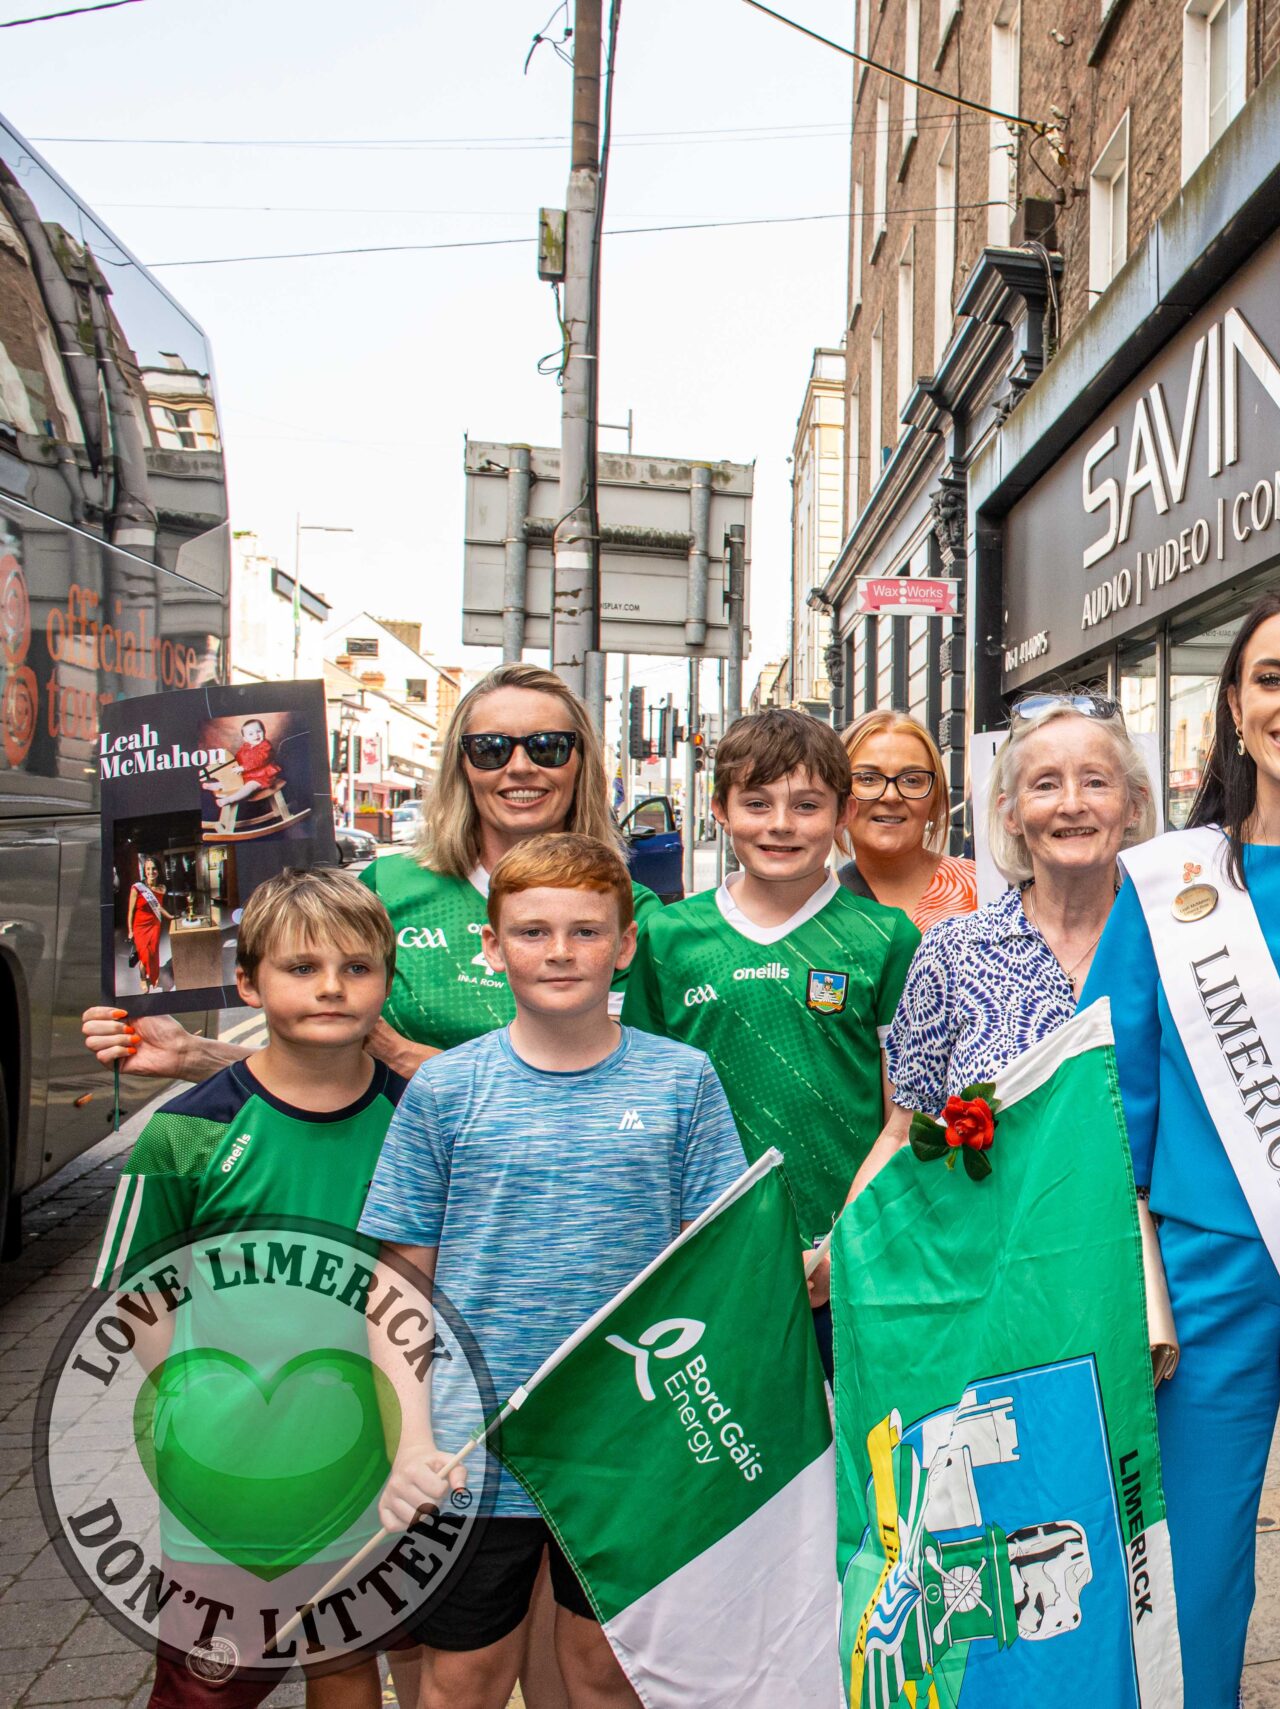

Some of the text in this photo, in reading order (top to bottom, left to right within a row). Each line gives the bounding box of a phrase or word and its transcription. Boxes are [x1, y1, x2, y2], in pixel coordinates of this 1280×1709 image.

[873, 585, 944, 598] Wax Works
[1081, 568, 1132, 630] AUDIO
[1147, 519, 1209, 591] VIDEO
[99, 723, 160, 756] Leah
[99, 746, 228, 780] McMahon
[480, 979, 505, 989] ROW
[663, 1370, 720, 1464] Energy
[685, 1354, 763, 1481] Bord Gáis
[1118, 1449, 1153, 1626] LIMERICK
